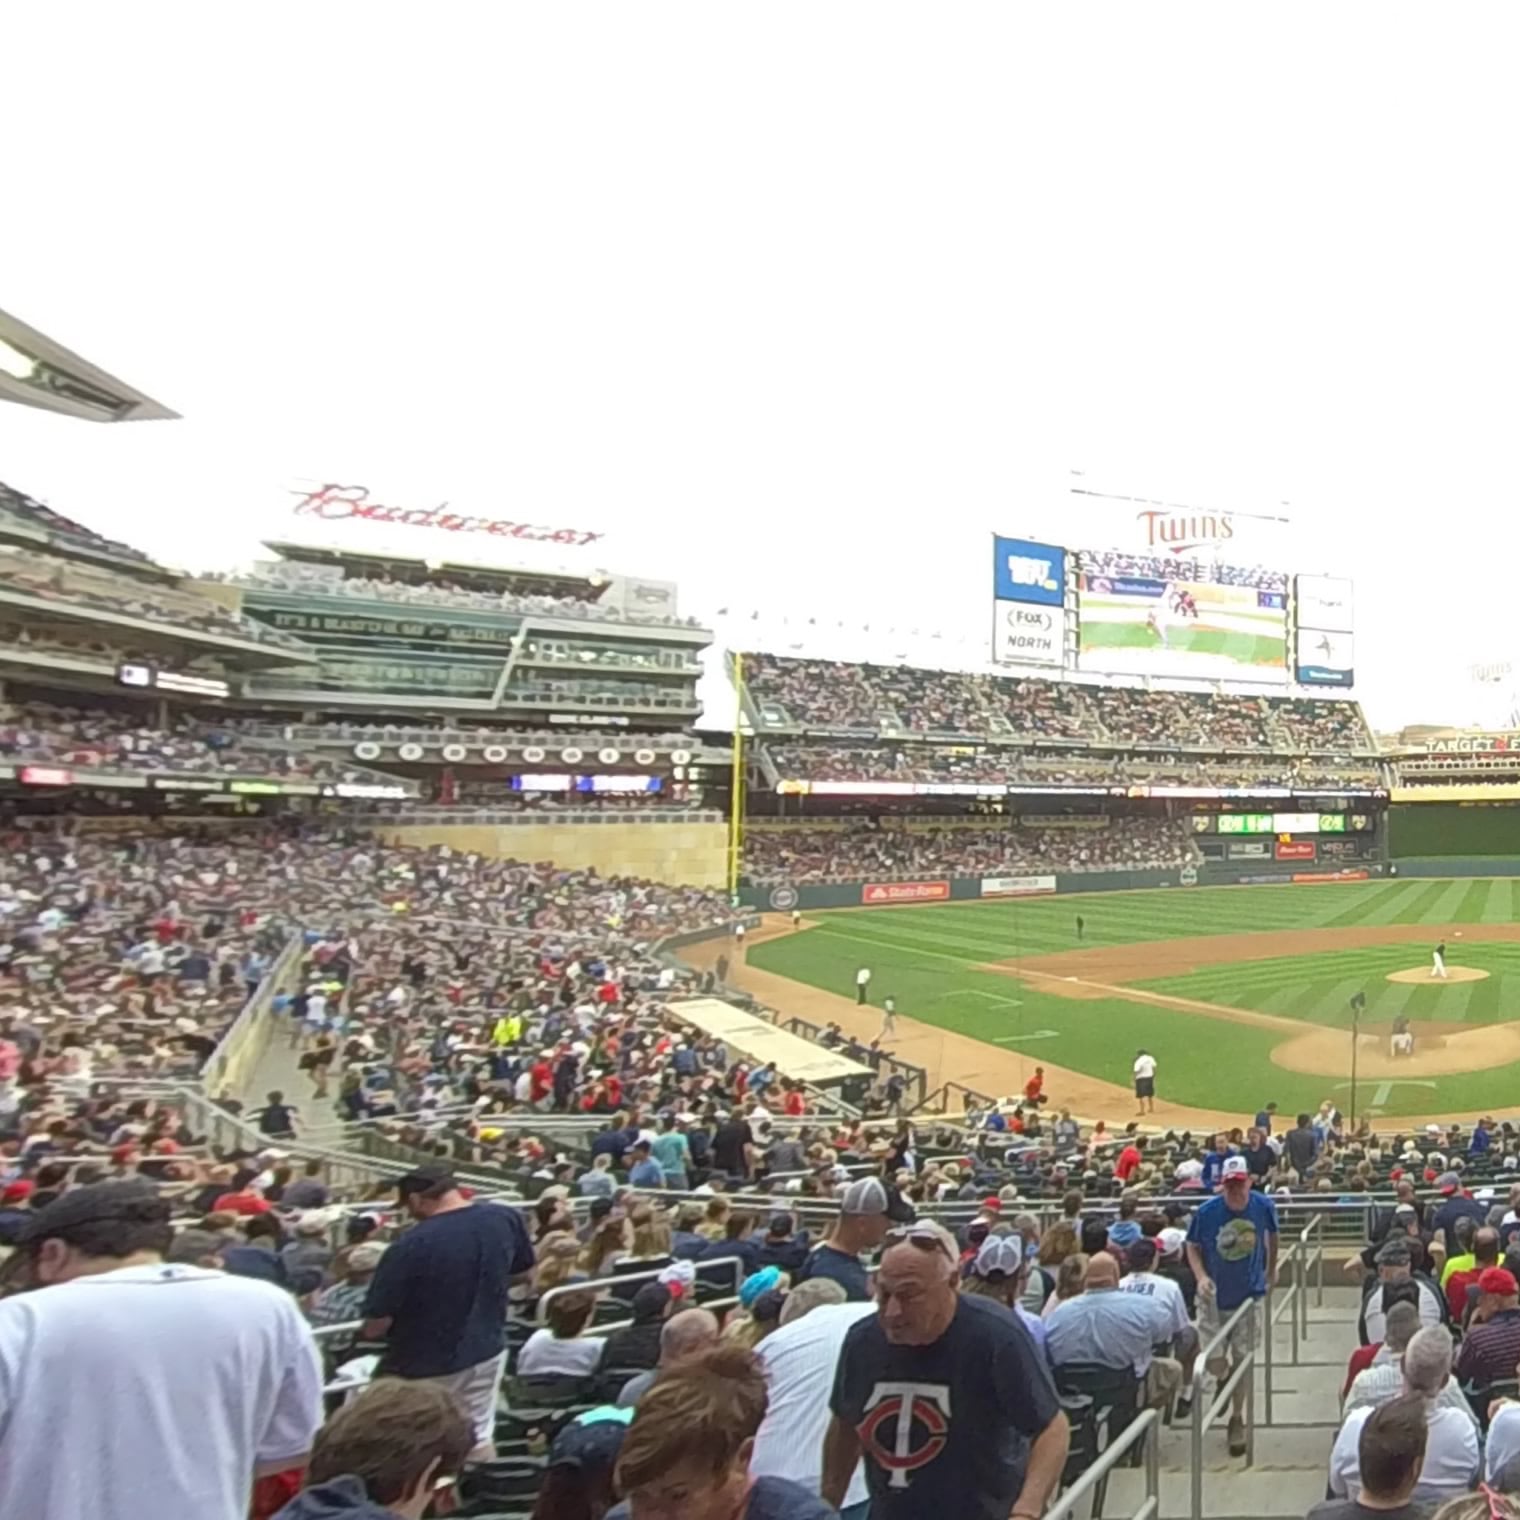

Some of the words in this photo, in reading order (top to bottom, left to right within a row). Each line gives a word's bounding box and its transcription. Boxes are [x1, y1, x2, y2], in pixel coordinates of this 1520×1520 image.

[1136, 511, 1233, 546] Twins
[1016, 611, 1043, 624] FOX
[1008, 636, 1052, 650] NORTH
[1425, 738, 1494, 752] TARGET
